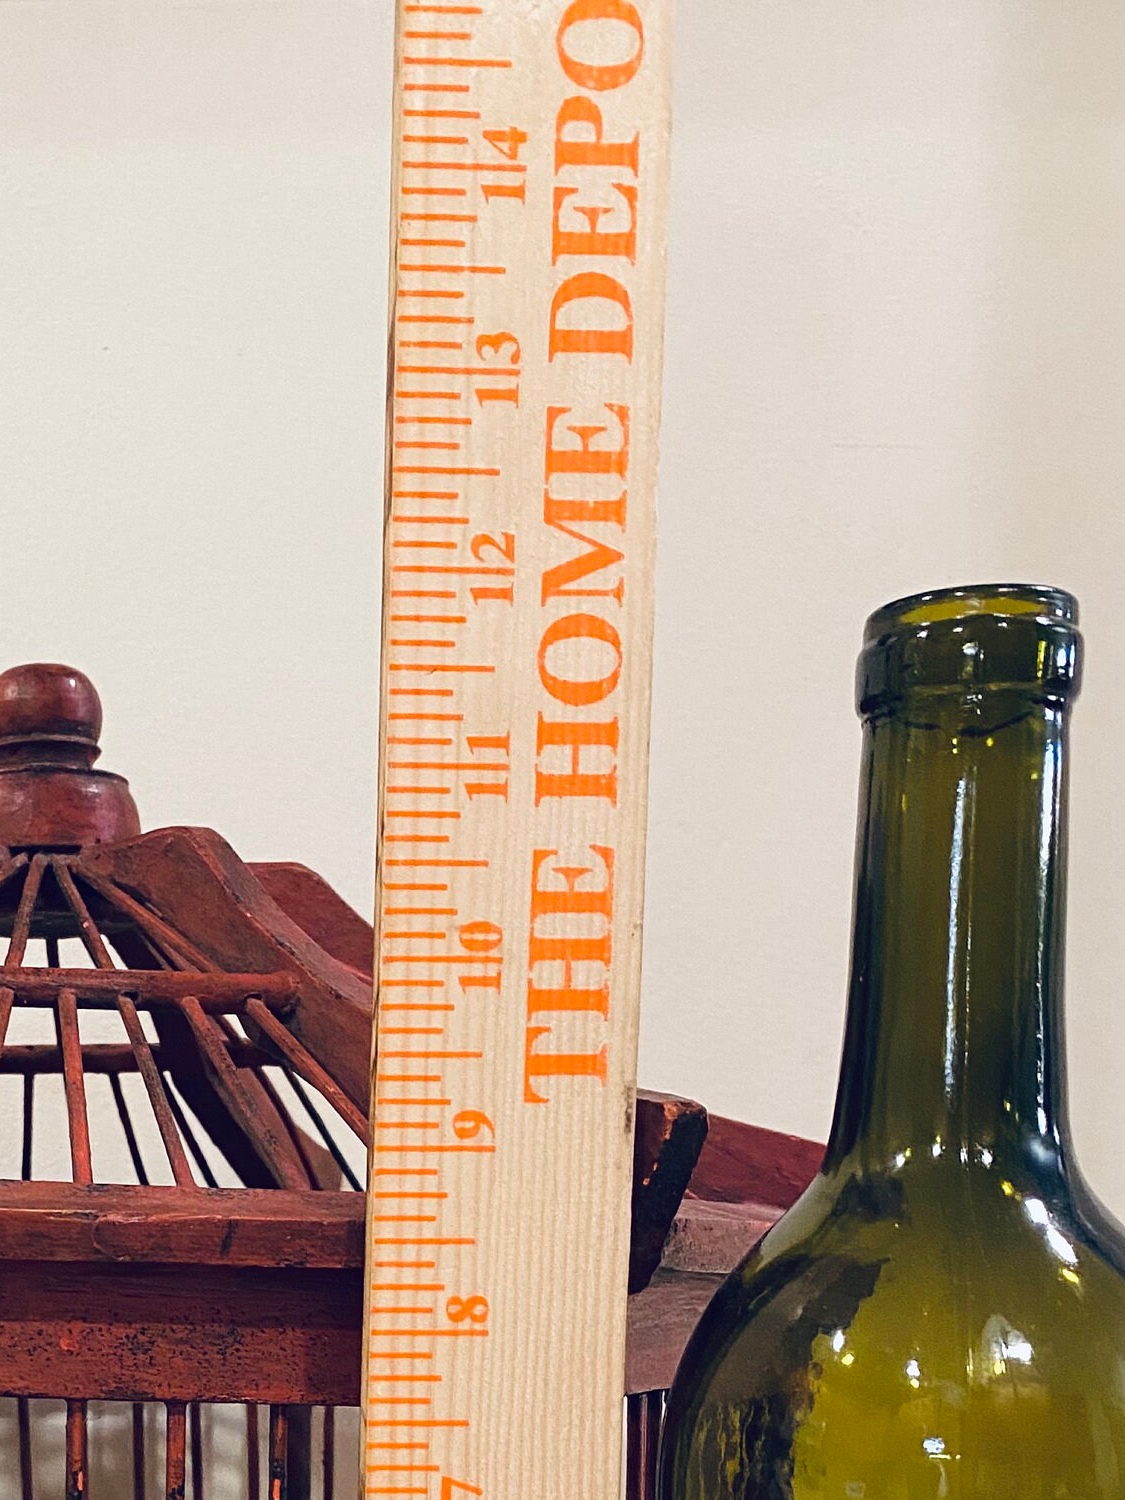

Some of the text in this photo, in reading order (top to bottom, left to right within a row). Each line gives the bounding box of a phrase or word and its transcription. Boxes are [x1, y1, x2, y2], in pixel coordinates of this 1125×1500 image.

[480, 126, 528, 205] 14
[474, 331, 521, 409] 13
[469, 531, 515, 606] 12
[534, 402, 630, 808] HOME
[464, 730, 511, 804] 11
[458, 921, 504, 995] 10
[524, 844, 615, 1104] THE
[452, 1109, 495, 1140] 9
[445, 1295, 490, 1324] 8
